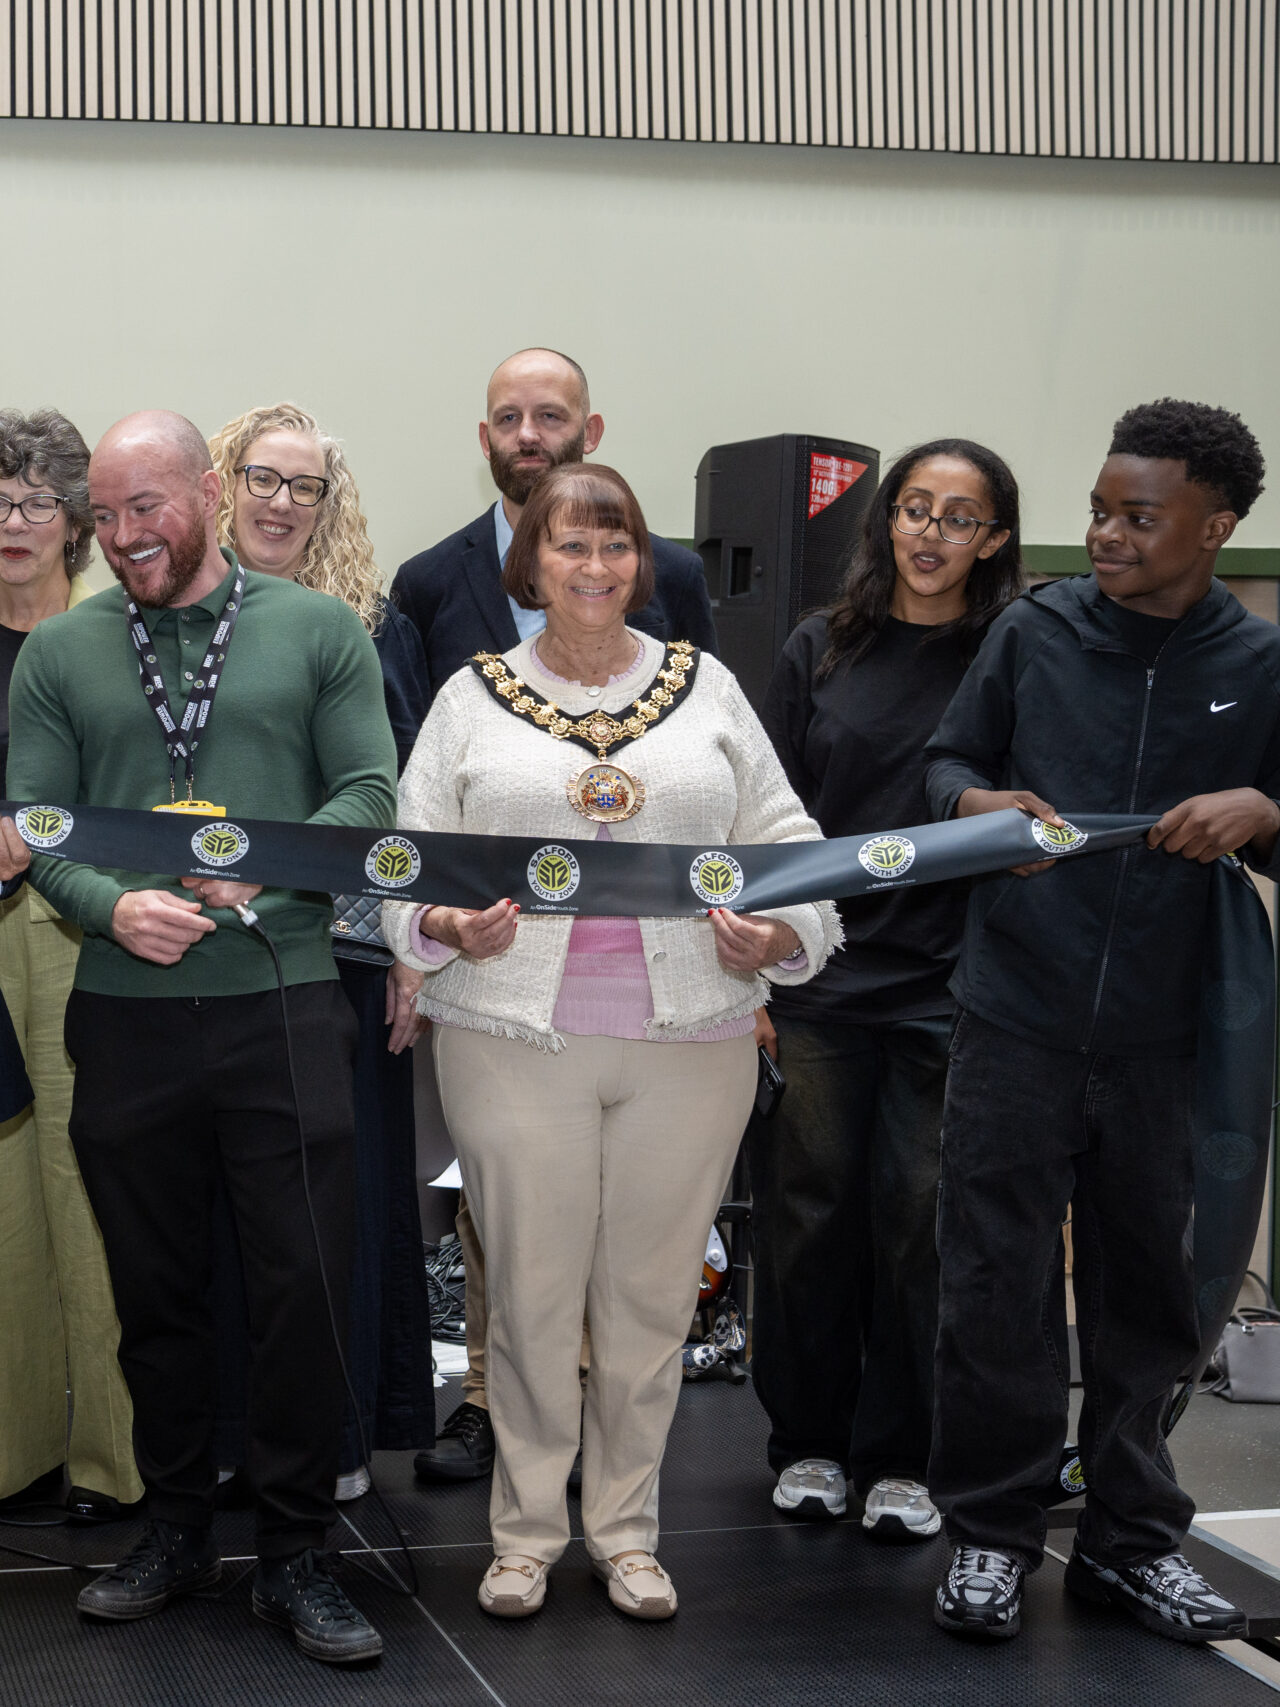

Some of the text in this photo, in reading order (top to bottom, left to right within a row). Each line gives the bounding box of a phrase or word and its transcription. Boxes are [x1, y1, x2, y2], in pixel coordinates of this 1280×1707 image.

[19, 806, 70, 820] SALFORD
[19, 824, 67, 845] YOUTH ZONE
[196, 824, 247, 844] SALFORD
[370, 837, 418, 862] SALFORD
[861, 836, 910, 855] SALFORD
[1040, 837, 1065, 852] YOUTH
[195, 846, 243, 864] YOUTH ZONE
[530, 846, 577, 870] SALFORD
[692, 853, 739, 873] SALFORD
[865, 855, 913, 877] YOUTH ZONE
[368, 869, 416, 887] YOUTH ZONE
[531, 880, 577, 899] YOUTH ZONE
[695, 883, 740, 903] YOUTH ZONE
